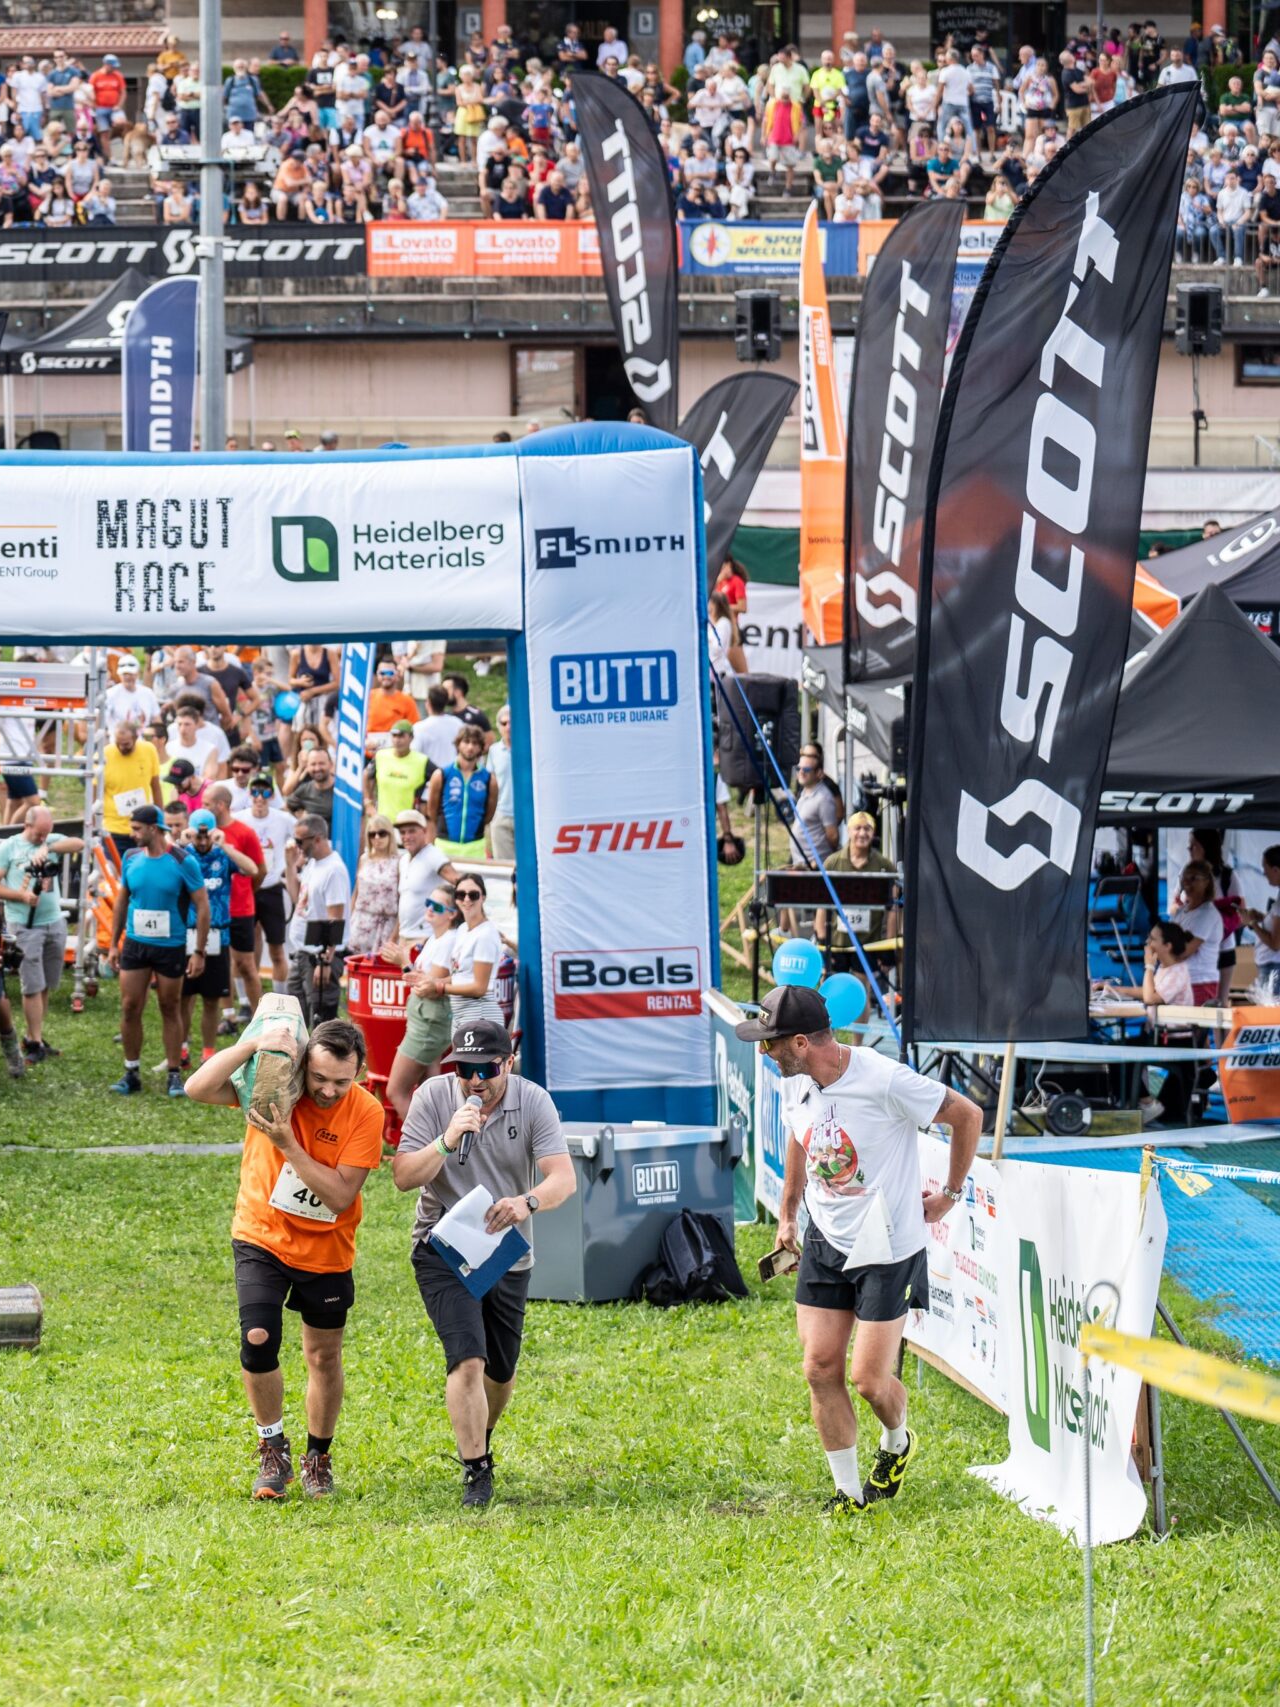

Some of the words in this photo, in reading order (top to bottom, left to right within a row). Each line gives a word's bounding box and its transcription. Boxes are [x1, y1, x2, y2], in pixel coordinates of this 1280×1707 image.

[387, 234, 452, 249] Lovato
[490, 234, 556, 249] Lovato
[37, 356, 113, 369] SCOTT
[874, 260, 940, 567] SCOTT
[1001, 191, 1120, 763] SCOTT
[96, 498, 233, 548] MAGUT
[353, 521, 504, 545] Heidelberg
[353, 546, 485, 571] Materials
[23, 566, 58, 580] Group
[115, 561, 215, 612] RACE
[559, 657, 670, 705] BUTTI
[560, 711, 604, 726] PENSATO
[607, 710, 627, 723] PER
[630, 709, 669, 722] DURARE
[1098, 790, 1255, 814] SCOTT
[552, 820, 684, 855] STIHL
[145, 920, 158, 929] 41
[560, 957, 694, 987] Boels
[780, 955, 807, 970] BUTTI
[372, 978, 407, 1004] BUT
[646, 994, 694, 1011] RENTAL
[636, 1165, 677, 1193] BUTTI
[262, 1427, 273, 1435] 40
